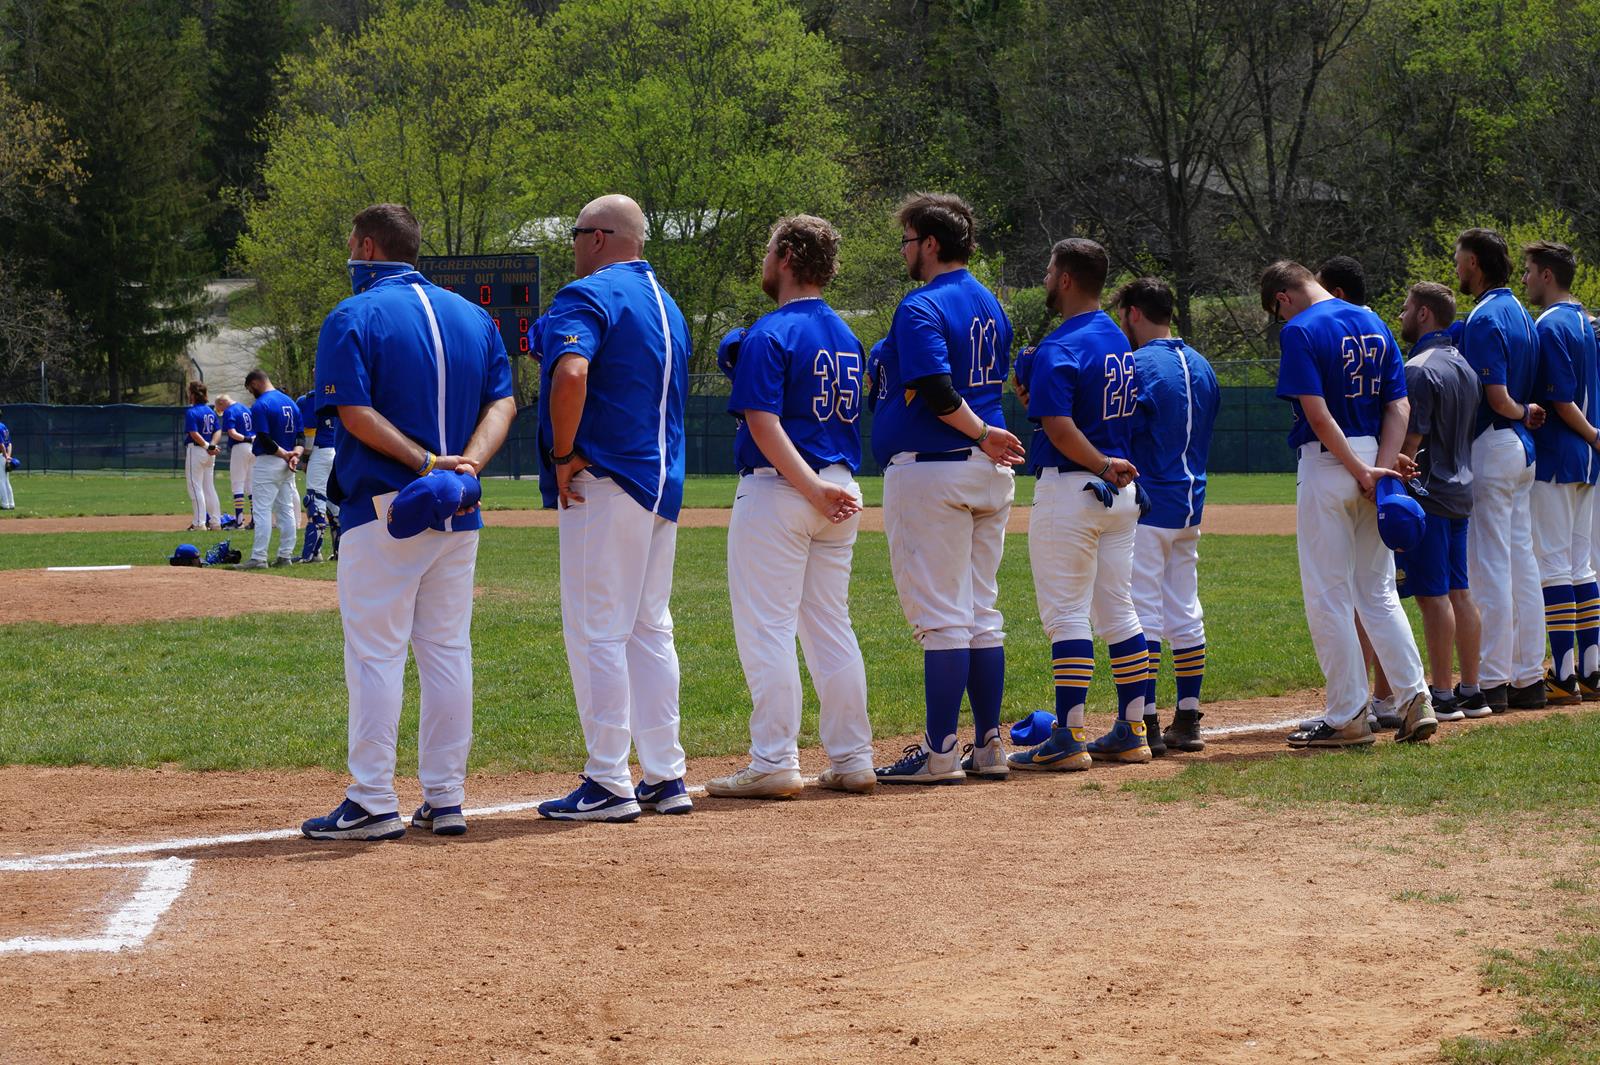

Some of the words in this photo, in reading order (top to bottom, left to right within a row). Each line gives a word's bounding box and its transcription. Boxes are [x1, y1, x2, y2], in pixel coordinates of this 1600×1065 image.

[474, 272, 495, 284] OUT
[502, 272, 537, 283] INNING
[480, 285, 491, 305] 0
[520, 318, 528, 333] 0
[520, 337, 528, 352] 0
[1341, 334, 1387, 399] 27
[325, 385, 336, 394] SA
[813, 349, 861, 424] 35
[1103, 352, 1138, 421] 22
[282, 406, 294, 433] 7
